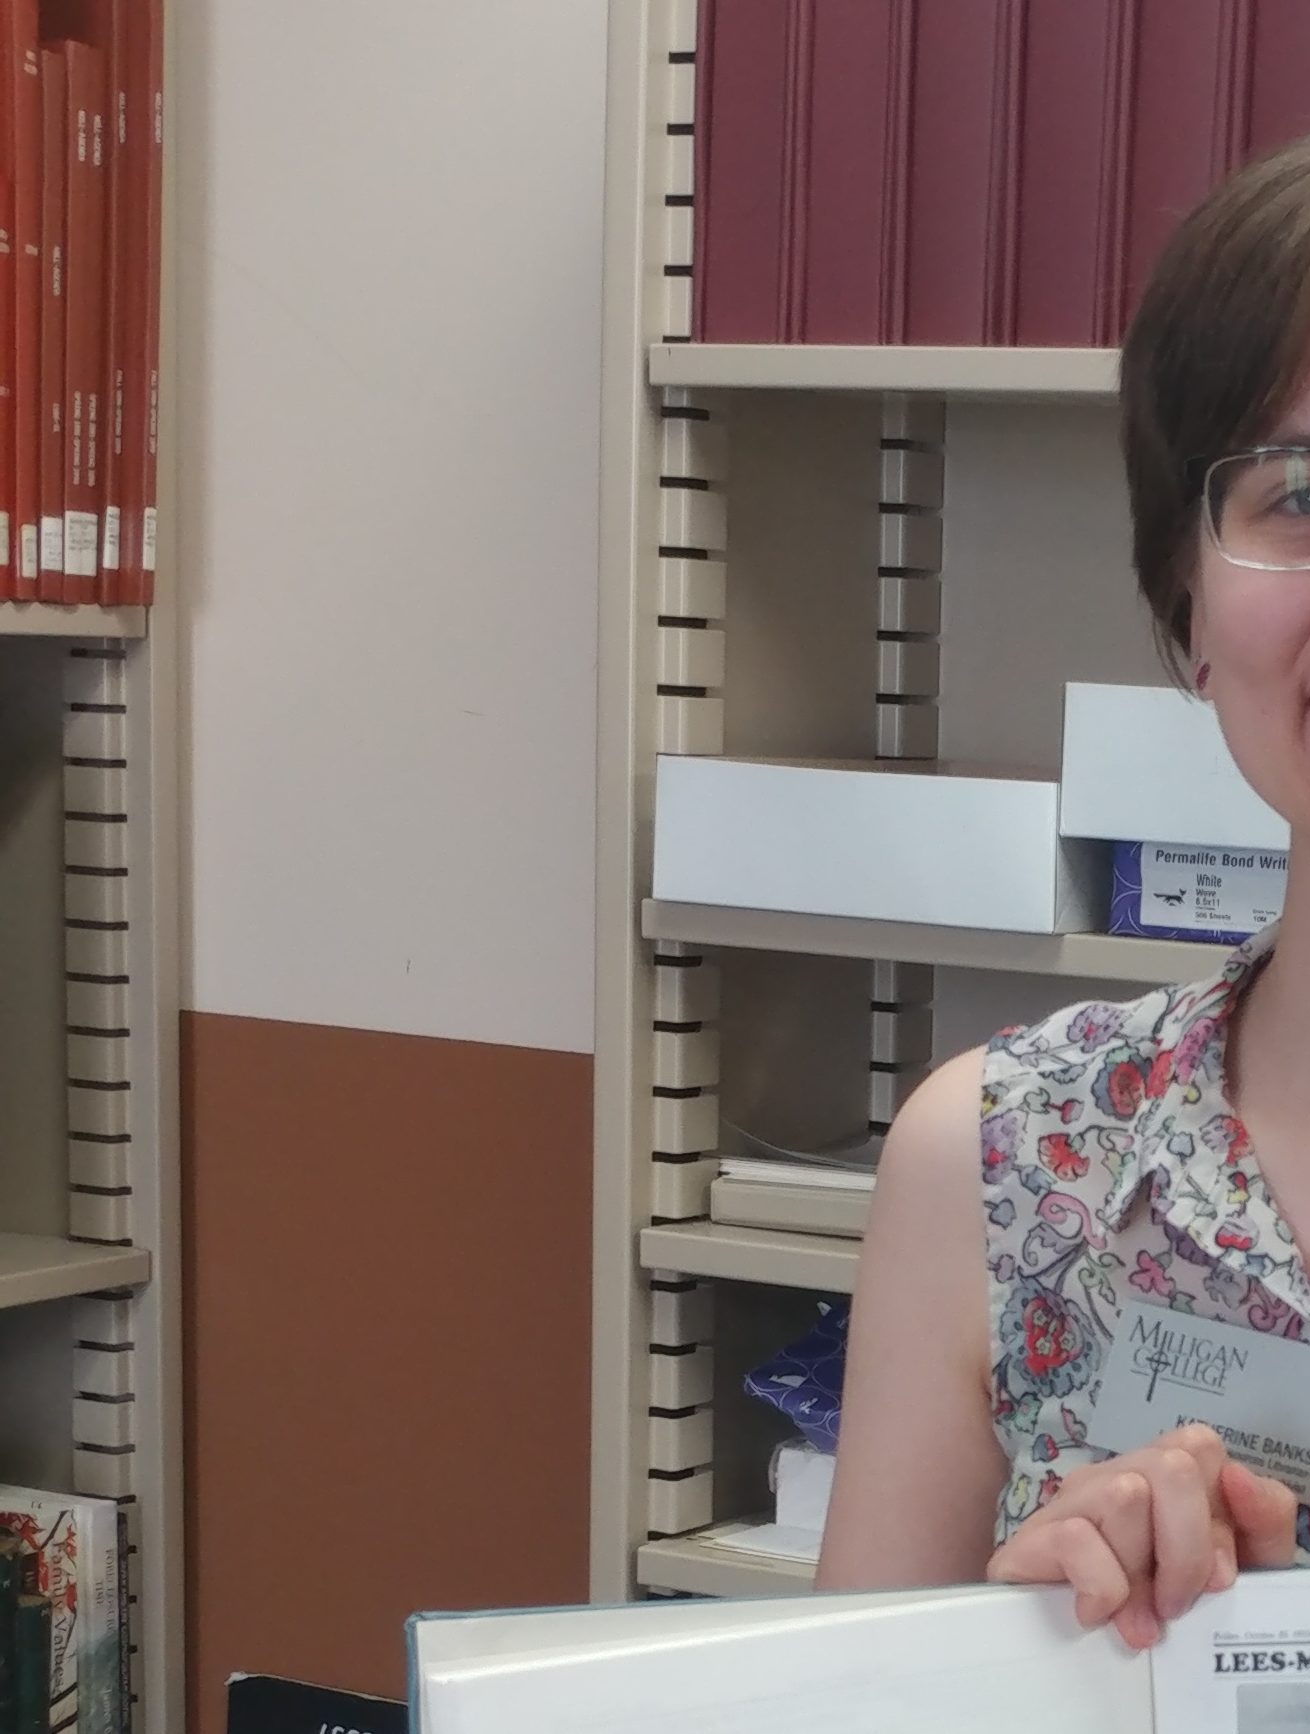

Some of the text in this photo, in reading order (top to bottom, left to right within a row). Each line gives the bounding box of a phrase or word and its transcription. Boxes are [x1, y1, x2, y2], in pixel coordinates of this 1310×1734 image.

[1156, 849, 1216, 866] Permalife
[1222, 853, 1253, 868] Bond
[1196, 873, 1222, 888] White
[1129, 1315, 1249, 1371] MILLIGAN
[1176, 1413, 1259, 1450] KERINE
[51, 1541, 67, 1610] Family
